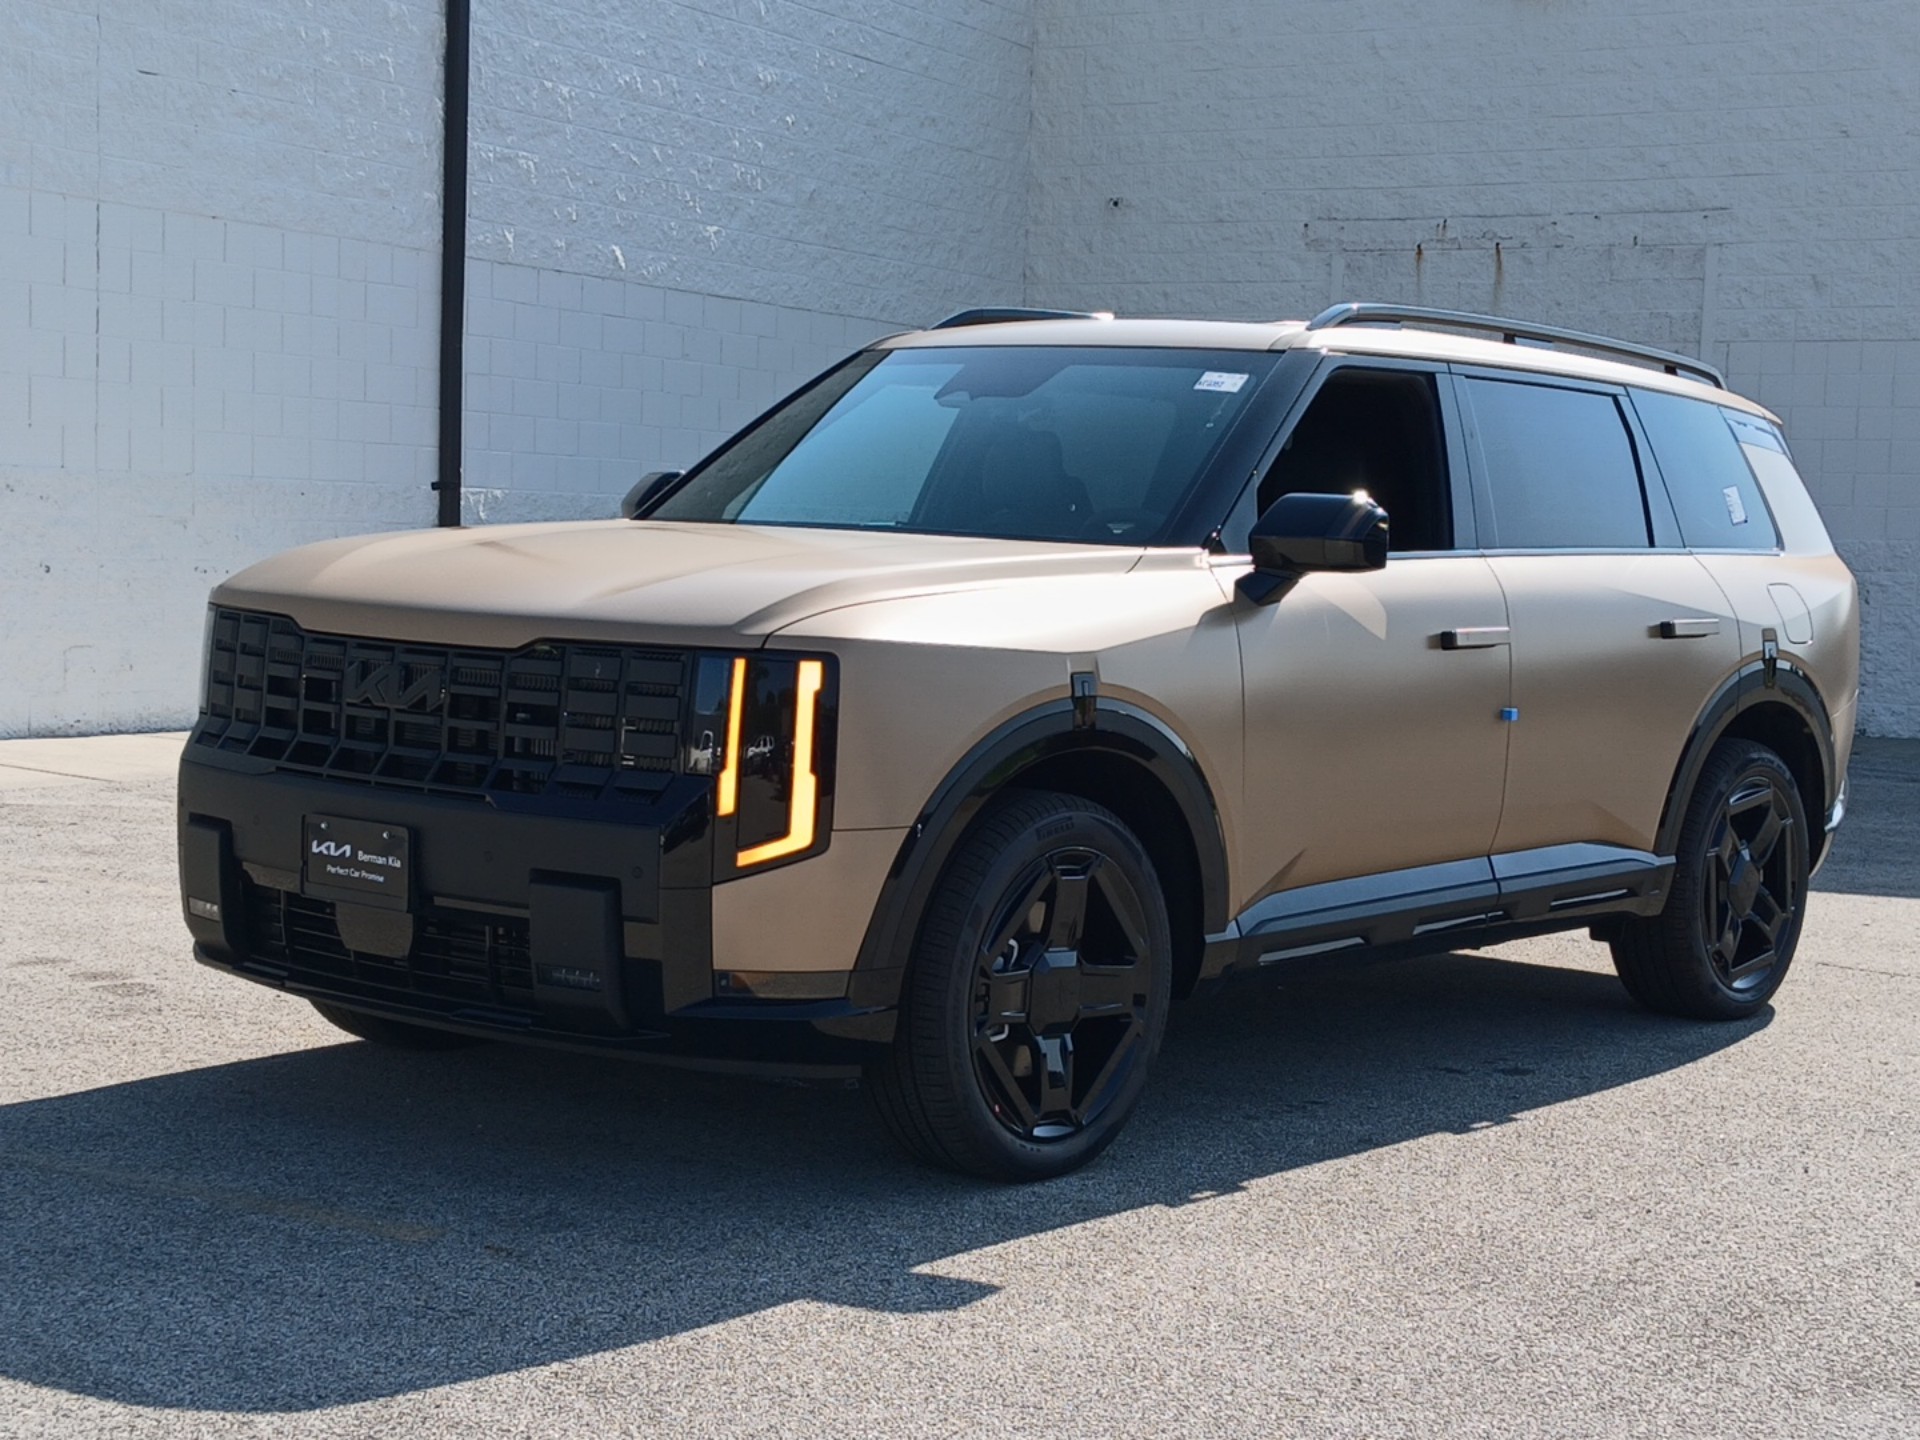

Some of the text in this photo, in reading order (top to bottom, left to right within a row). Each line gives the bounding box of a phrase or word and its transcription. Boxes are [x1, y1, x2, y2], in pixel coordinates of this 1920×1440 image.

[342, 660, 443, 711] KIA
[311, 840, 351, 858] KIA
[357, 850, 401, 868] Berman Kia
[326, 864, 384, 883] Perfect Car Promise
